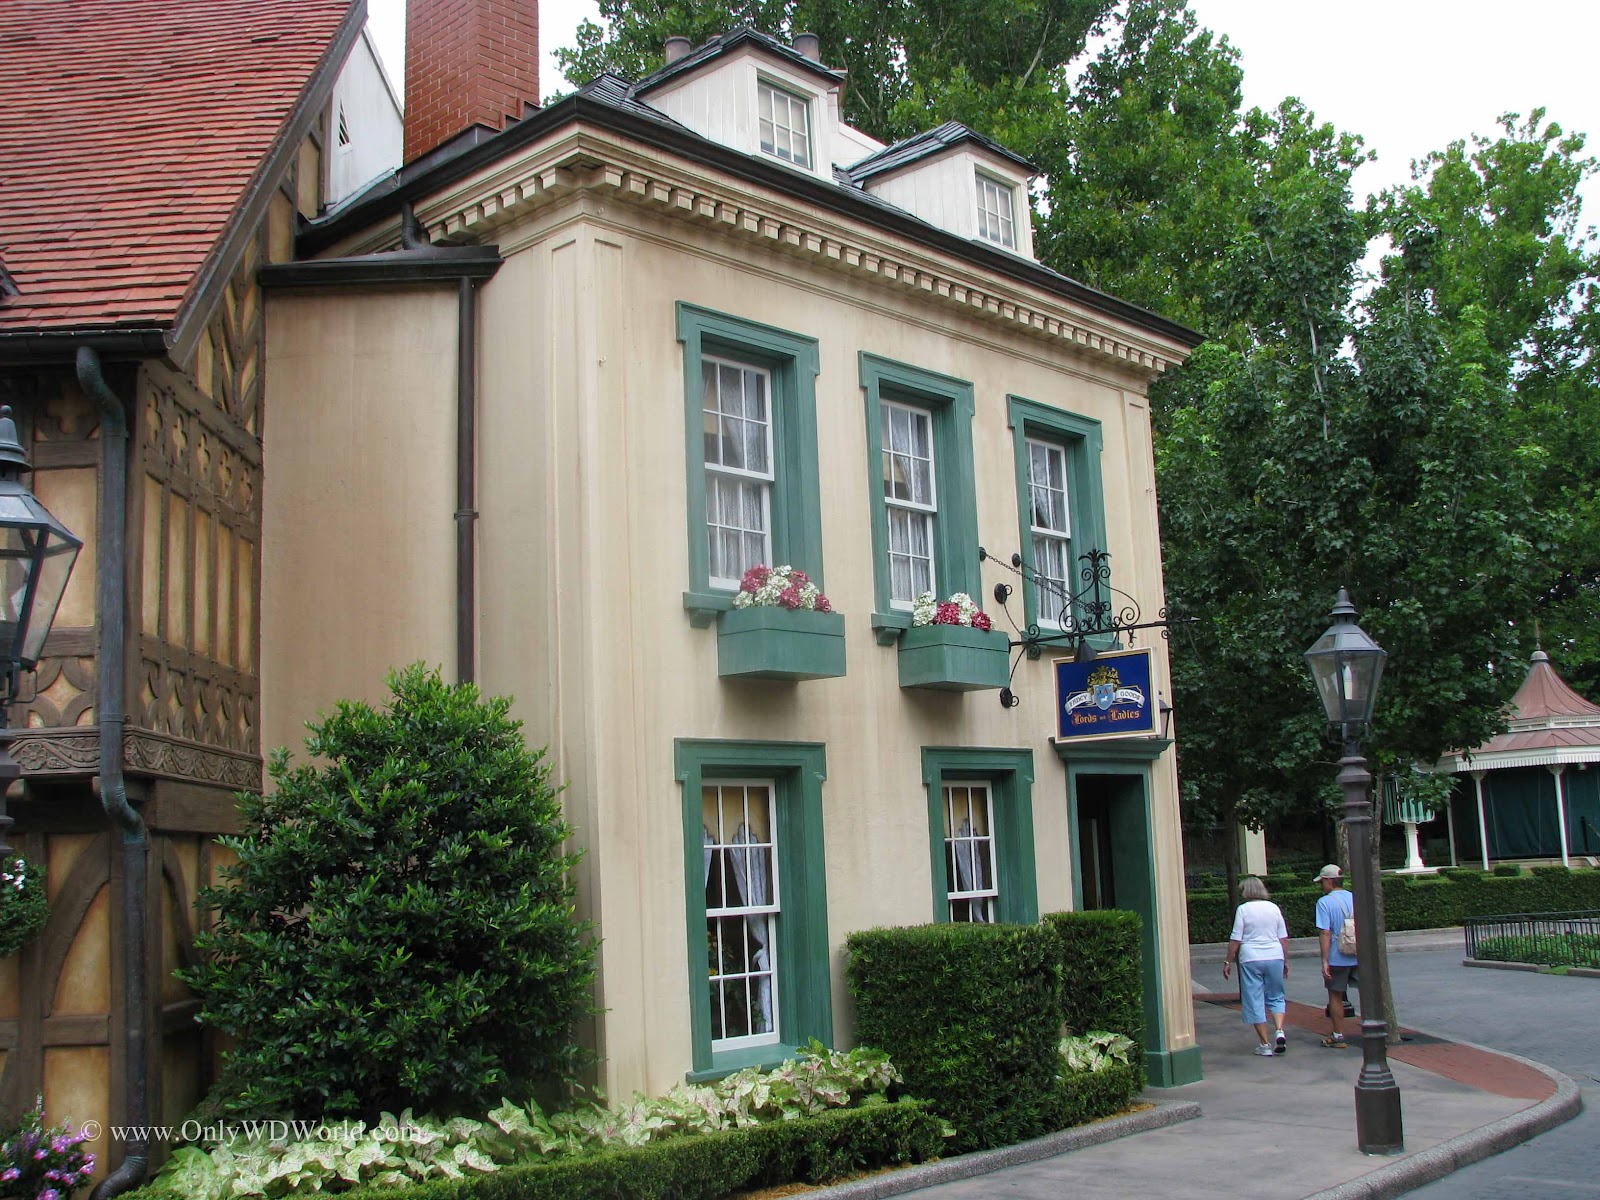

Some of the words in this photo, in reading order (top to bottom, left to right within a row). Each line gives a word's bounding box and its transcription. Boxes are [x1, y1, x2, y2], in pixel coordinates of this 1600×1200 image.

[1119, 691, 1141, 700] GOODS
[1073, 713, 1097, 725] Lords
[1110, 709, 1140, 721] Ladies
